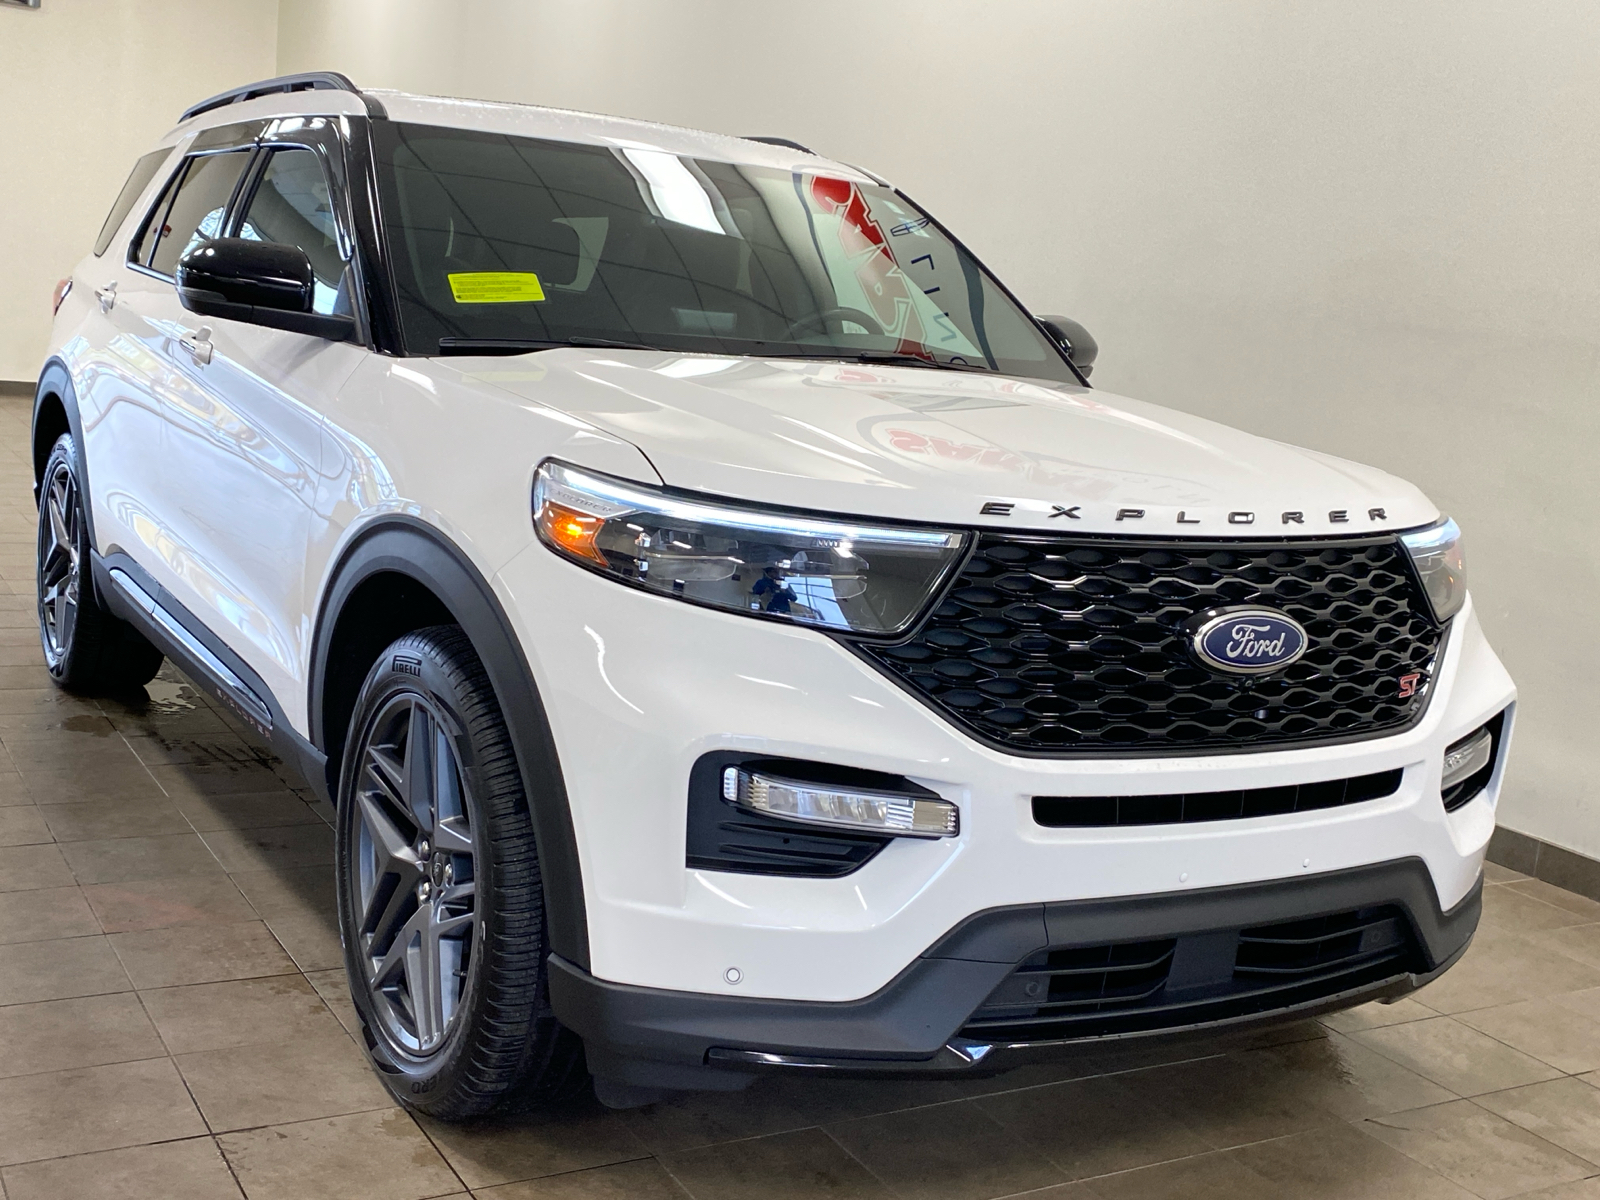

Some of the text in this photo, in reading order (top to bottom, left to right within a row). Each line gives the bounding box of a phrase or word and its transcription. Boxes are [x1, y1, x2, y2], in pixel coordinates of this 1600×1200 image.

[979, 501, 1388, 525] EXPLORER
[1226, 624, 1286, 658] Ford
[392, 654, 423, 677] PIRELLI
[1398, 673, 1421, 698] ST
